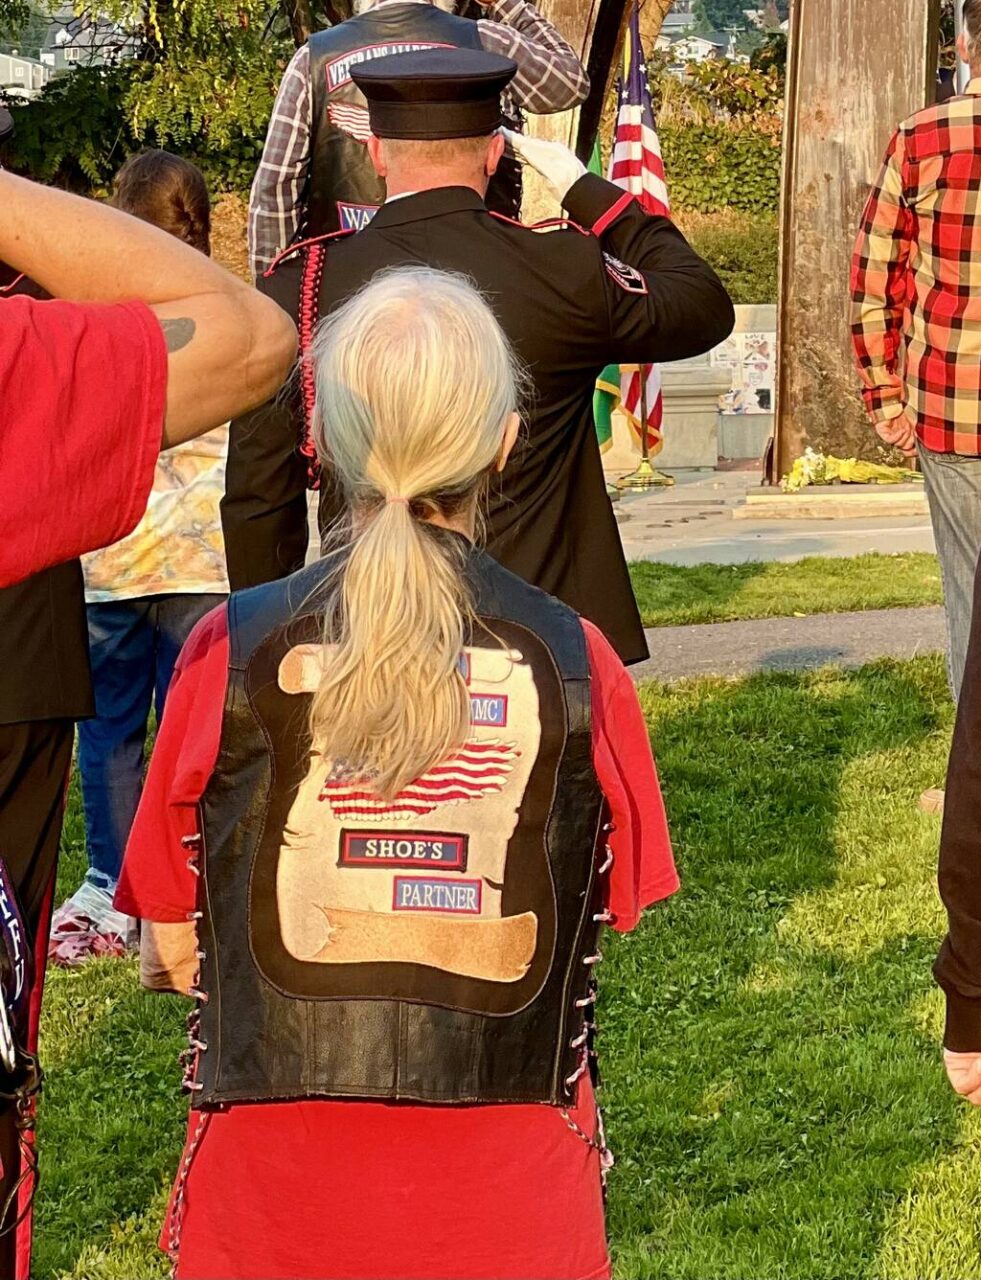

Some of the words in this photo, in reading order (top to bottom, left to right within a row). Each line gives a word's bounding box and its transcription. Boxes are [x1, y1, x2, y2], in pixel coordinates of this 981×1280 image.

[470, 698, 498, 721] MC
[365, 839, 443, 859] SHOE'S
[401, 883, 478, 910] PARTNER
